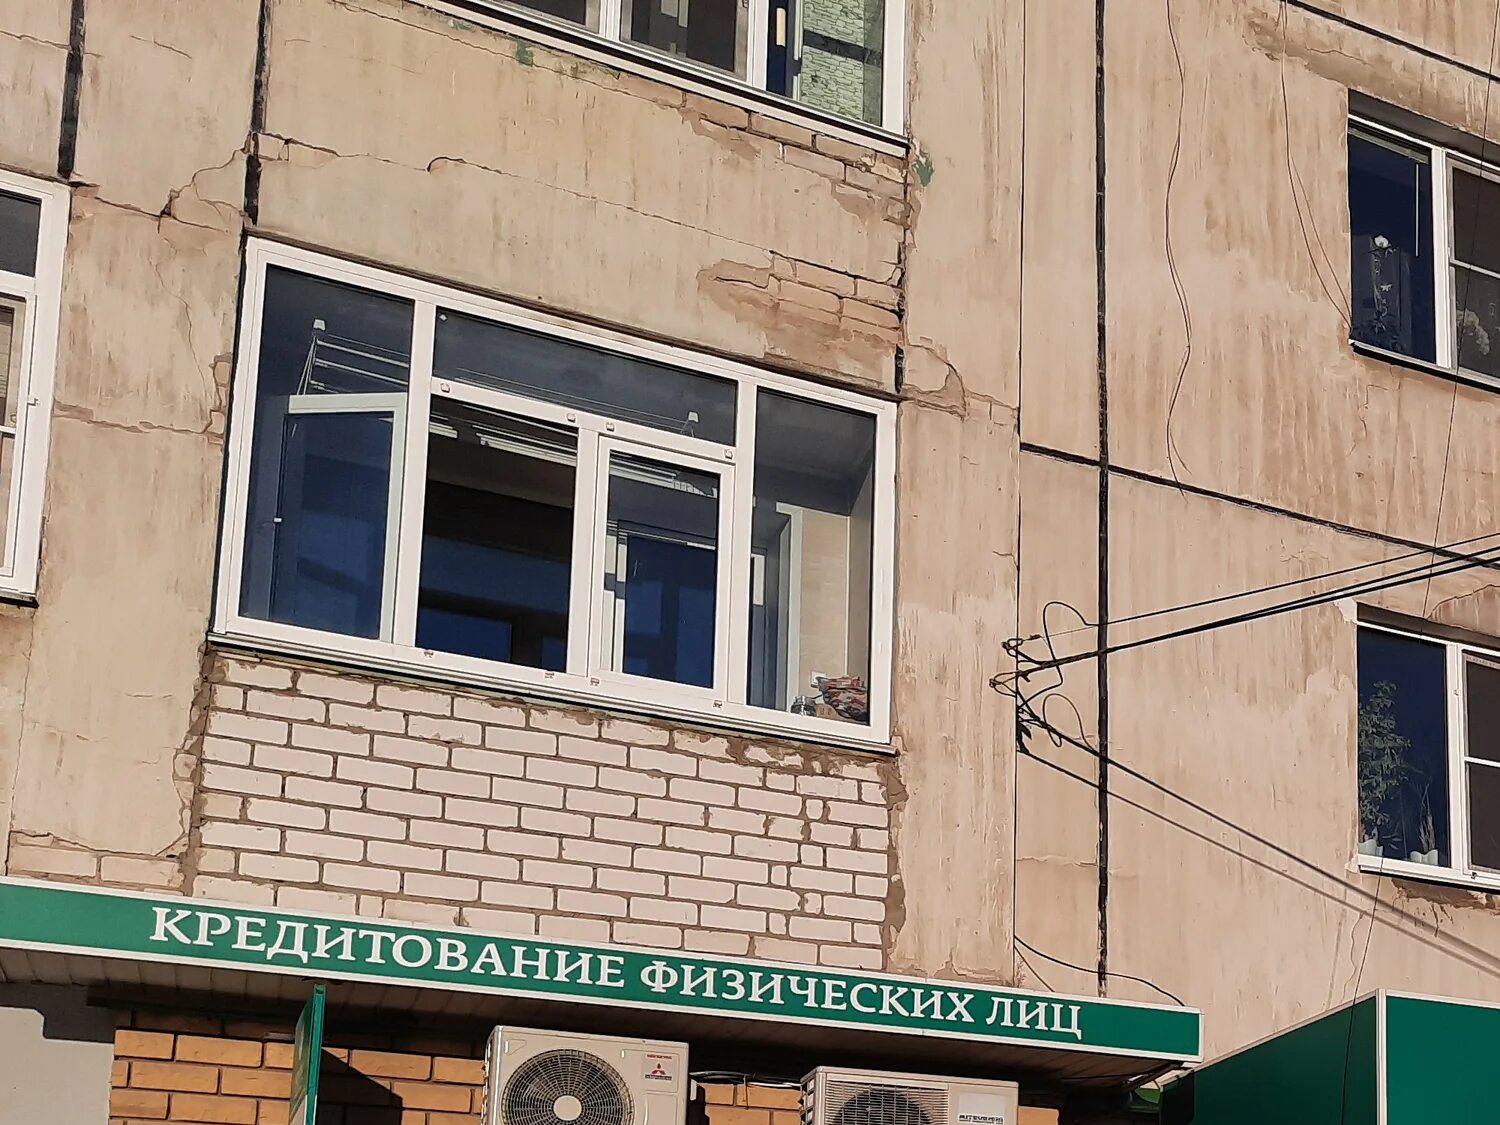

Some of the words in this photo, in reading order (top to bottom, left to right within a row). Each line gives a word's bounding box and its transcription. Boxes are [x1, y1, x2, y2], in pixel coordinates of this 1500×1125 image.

[149, 906, 625, 988] КРЕДИТОВАНИЕ
[640, 960, 975, 1023] ФИЗИЧЕСКИХ
[984, 995, 1082, 1040] ЛИЦ
